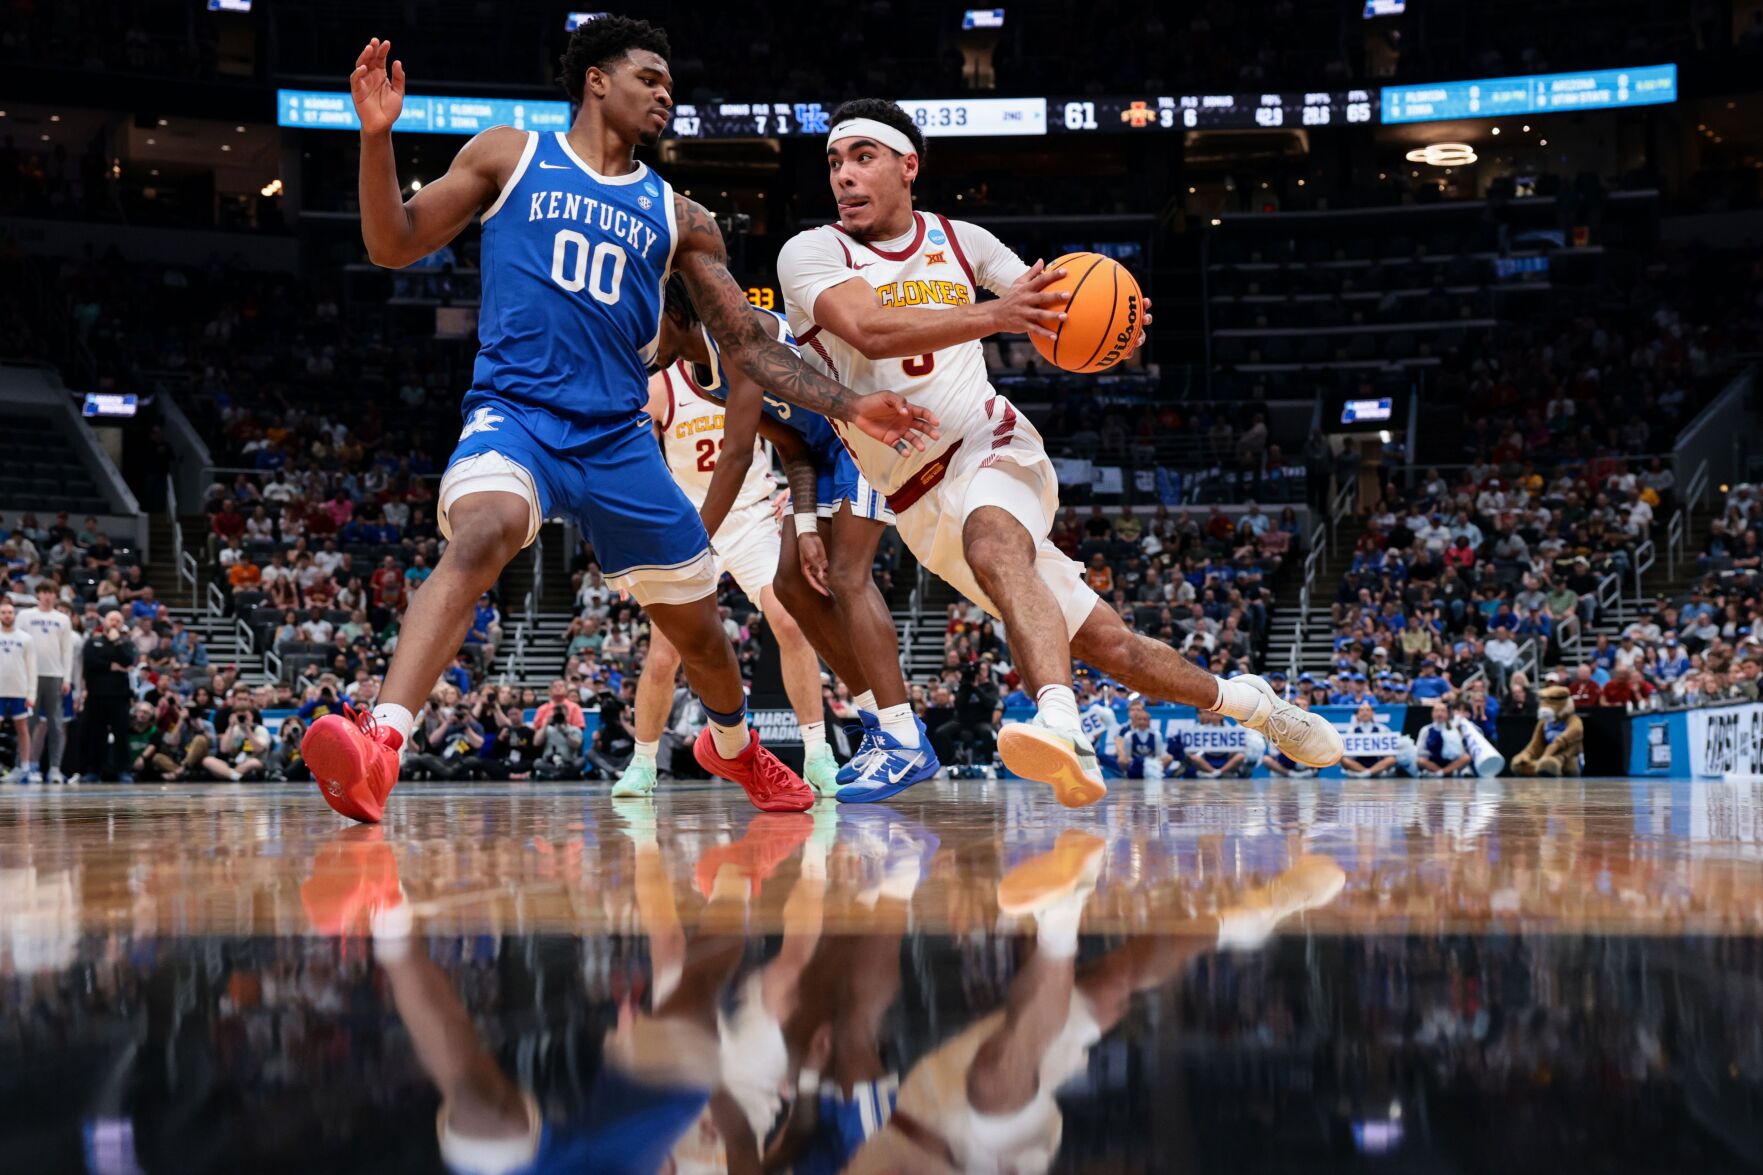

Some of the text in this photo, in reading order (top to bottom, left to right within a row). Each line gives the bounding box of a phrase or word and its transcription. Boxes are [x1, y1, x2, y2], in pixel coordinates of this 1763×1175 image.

[755, 116, 767, 134] 7
[777, 116, 789, 134] 1
[914, 107, 967, 127] 8:33
[1064, 102, 1098, 129] 61
[1161, 109, 1174, 128] 3
[1183, 108, 1198, 127] 6
[1346, 102, 1371, 122] 65
[528, 191, 657, 259] KENTUCKY
[551, 228, 627, 306] 00
[876, 280, 971, 308] CLONES
[1095, 295, 1137, 367] Wilson
[675, 415, 725, 439] CYCLO
[696, 438, 724, 473] 2
[753, 711, 799, 726] MARCH
[1183, 732, 1246, 747] DEFENSE
[1345, 736, 1399, 752] EFENSE
